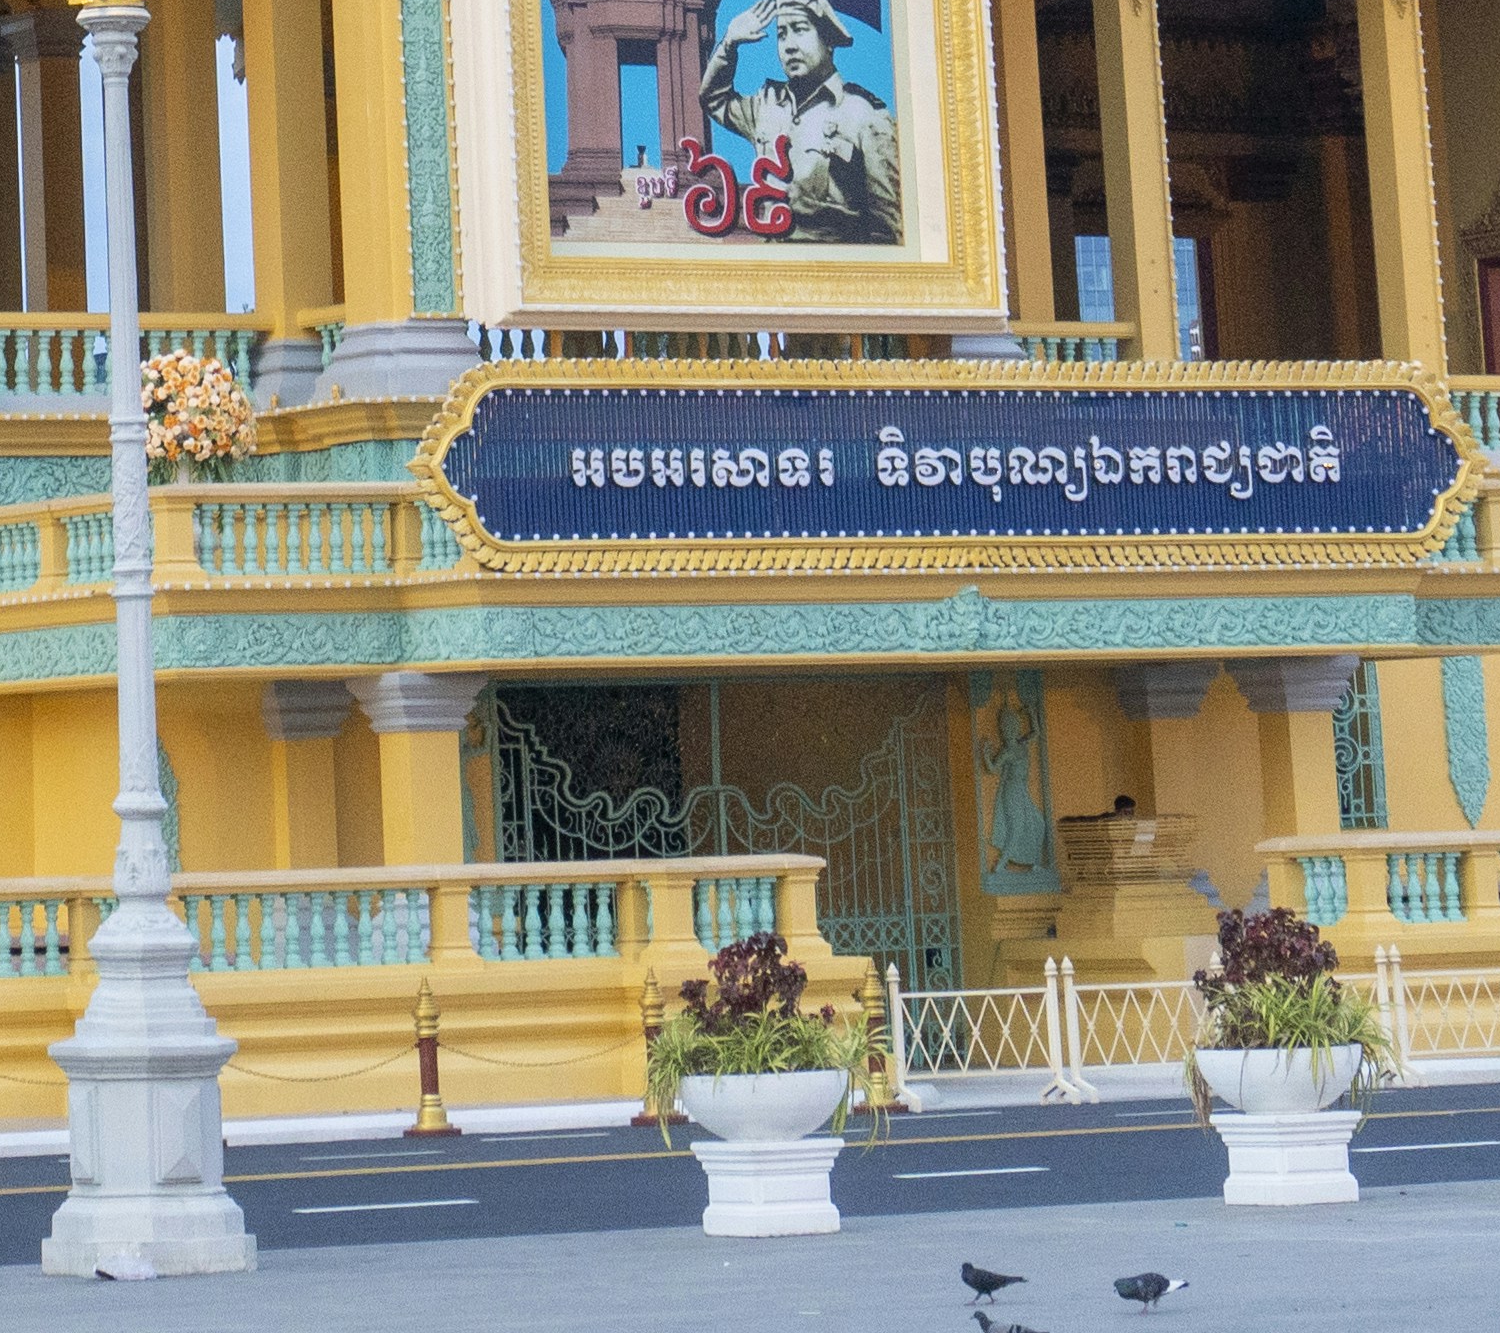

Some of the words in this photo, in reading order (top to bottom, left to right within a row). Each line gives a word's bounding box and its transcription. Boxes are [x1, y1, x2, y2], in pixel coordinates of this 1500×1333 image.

[679, 134, 795, 237] ៦៩
[570, 446, 835, 488] អបអរសាទរ
